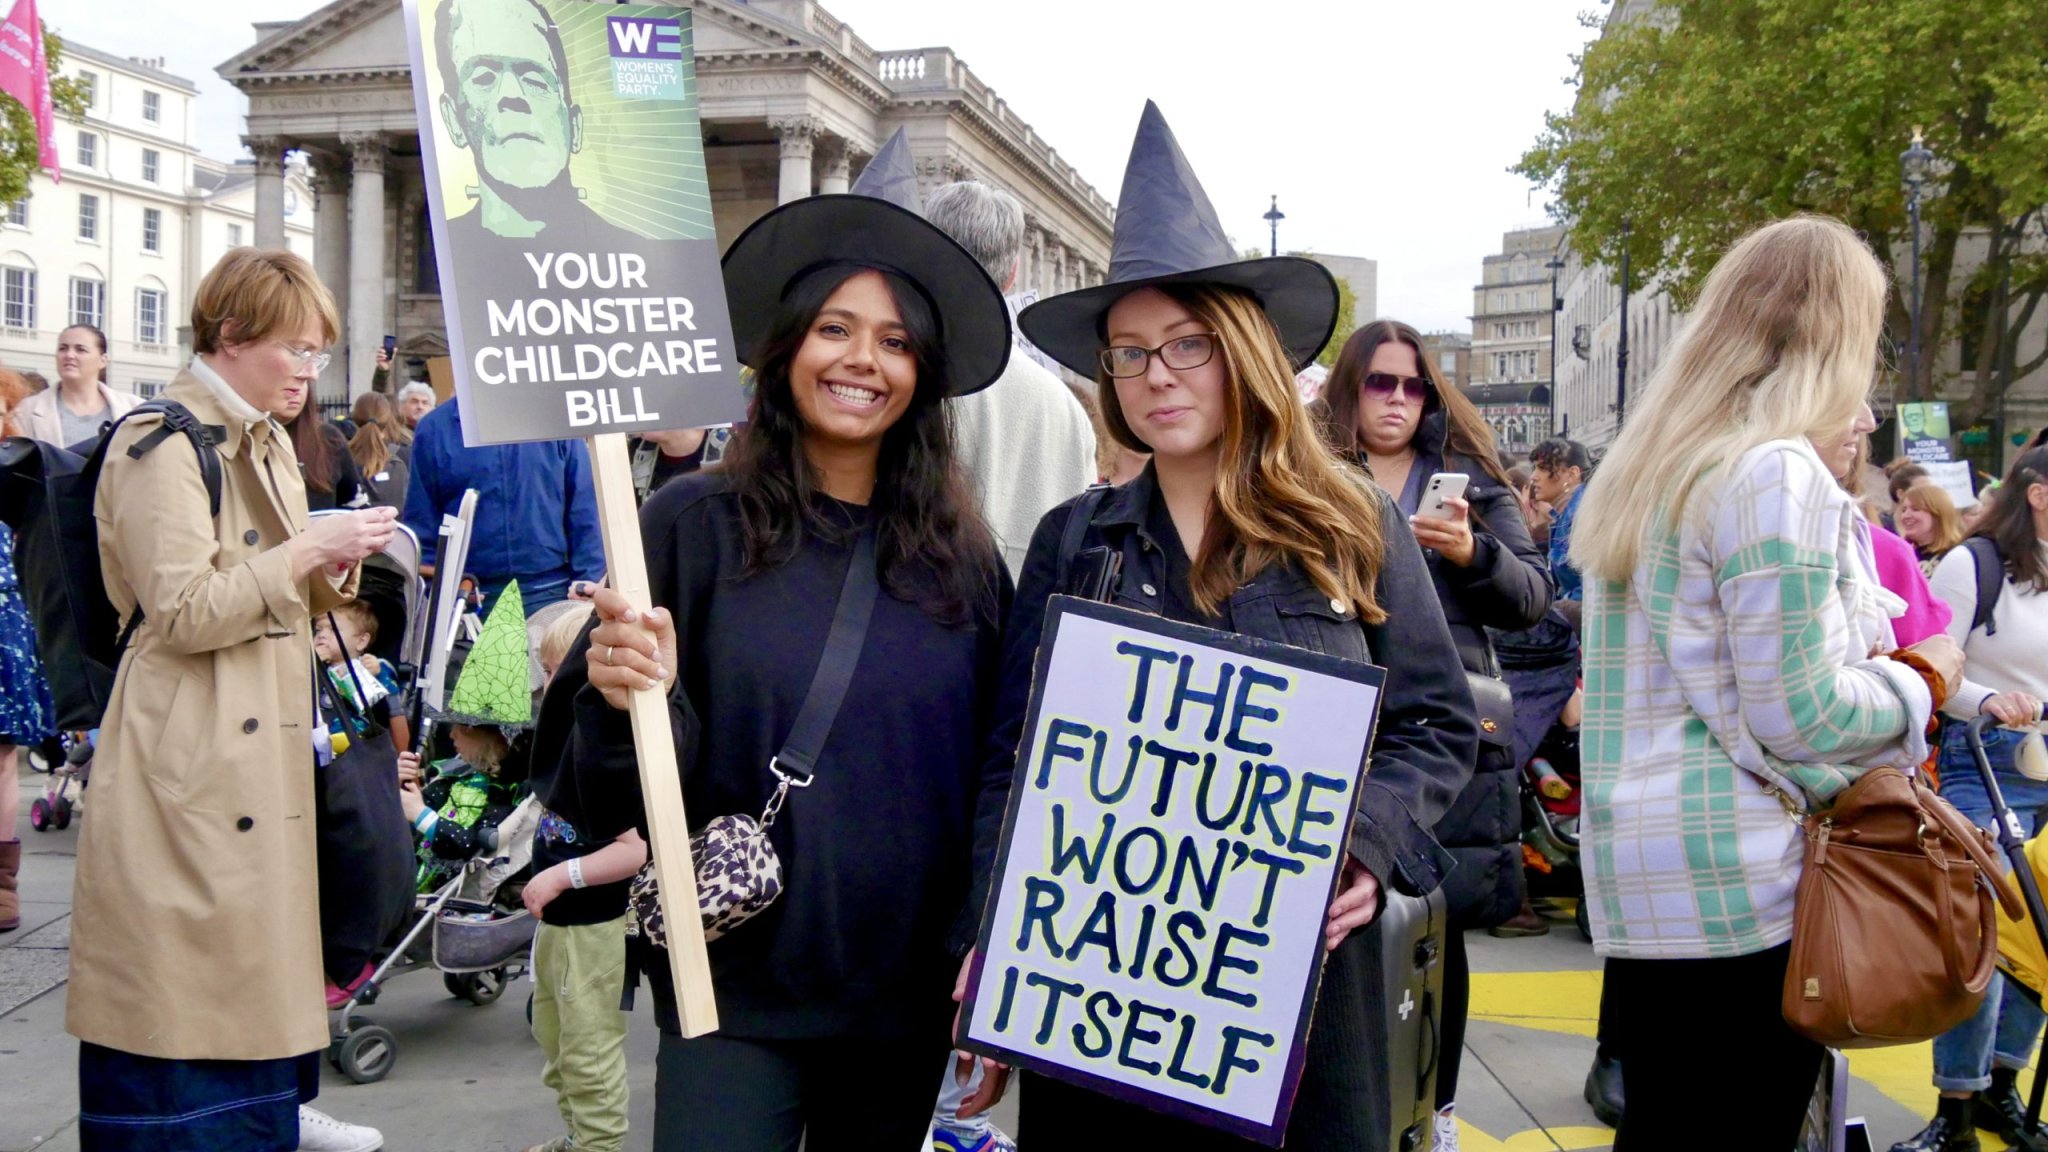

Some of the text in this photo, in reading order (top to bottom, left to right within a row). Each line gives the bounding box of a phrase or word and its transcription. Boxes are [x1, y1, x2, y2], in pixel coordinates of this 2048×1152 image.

[611, 21, 682, 54] WE
[615, 61, 675, 74] WOMEN'S
[616, 72, 678, 85] EQUALITY
[618, 83, 662, 96] PARTY.
[523, 252, 649, 290] YOUR
[486, 296, 698, 337] MONSTER
[474, 338, 722, 385] CHILDCARE
[565, 386, 660, 428] BILL
[1906, 446, 1947, 454] MONSTER
[1914, 439, 1938, 447] YOUR
[1116, 640, 1289, 757] THE
[1034, 718, 1348, 859] FUTURE
[1051, 803, 1306, 928] WON'T
[1016, 875, 1270, 1008] RAISE
[992, 965, 1276, 1095] ITSELF
